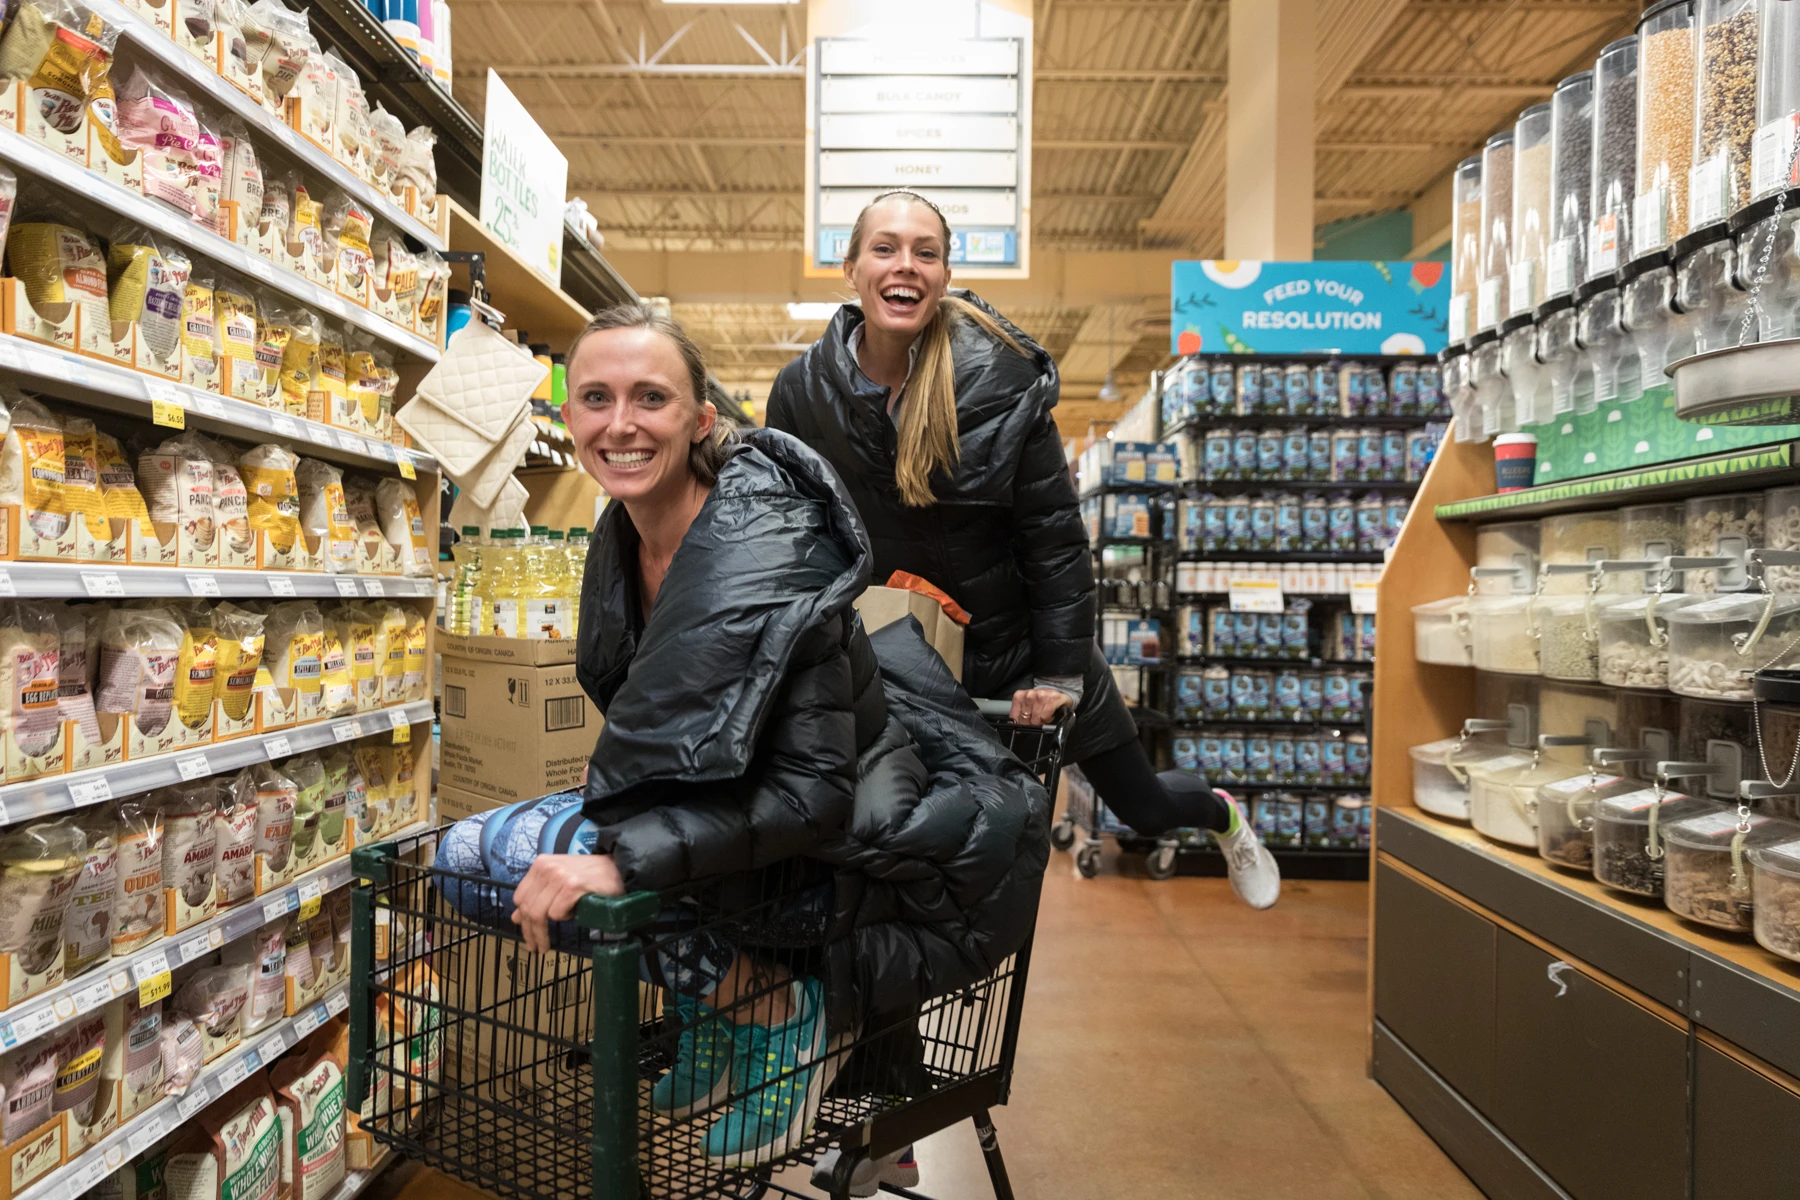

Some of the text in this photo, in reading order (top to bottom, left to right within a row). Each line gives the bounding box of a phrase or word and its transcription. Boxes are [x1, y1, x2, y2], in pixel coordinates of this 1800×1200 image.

[916, 92, 962, 101] CANDY
[55, 99, 80, 114] Red
[896, 128, 942, 137] SPICES
[161, 137, 182, 148] Pie
[895, 165, 941, 174] HONEY
[246, 182, 262, 197] BREA
[489, 150, 538, 219] BOTTLES
[942, 203, 969, 214] ODS
[1263, 279, 1365, 306] FEED YOUR
[1242, 311, 1382, 330] RESOLUTION
[168, 414, 184, 424] $6.50
[219, 495, 247, 509] PANCA
[446, 643, 466, 652] COUNTRY
[468, 646, 474, 654] OF
[494, 650, 515, 658] CANADA
[158, 661, 169, 676] Red
[544, 678, 553, 686] 12
[26, 693, 38, 704] EGG
[444, 750, 456, 758] Whole
[456, 752, 466, 761] Foods
[545, 756, 584, 768] Distributed
[545, 769, 568, 778] Whole
[452, 774, 473, 784] COUNTRY
[473, 778, 480, 786] OF
[498, 786, 518, 798] CANADA
[545, 776, 581, 788] Austin, TX
[222, 844, 253, 862] AMARA
[94, 860, 109, 878] Red
[124, 872, 161, 893] QUIN
[72, 890, 114, 908] TEF
[151, 957, 165, 967] $12.99
[150, 982, 170, 998] $11.99
[237, 1102, 268, 1156] Red Mill
[327, 1118, 344, 1148] FLO
[25, 1130, 54, 1168] Red Mill
[230, 1130, 281, 1200] WHOLE WHEAT
